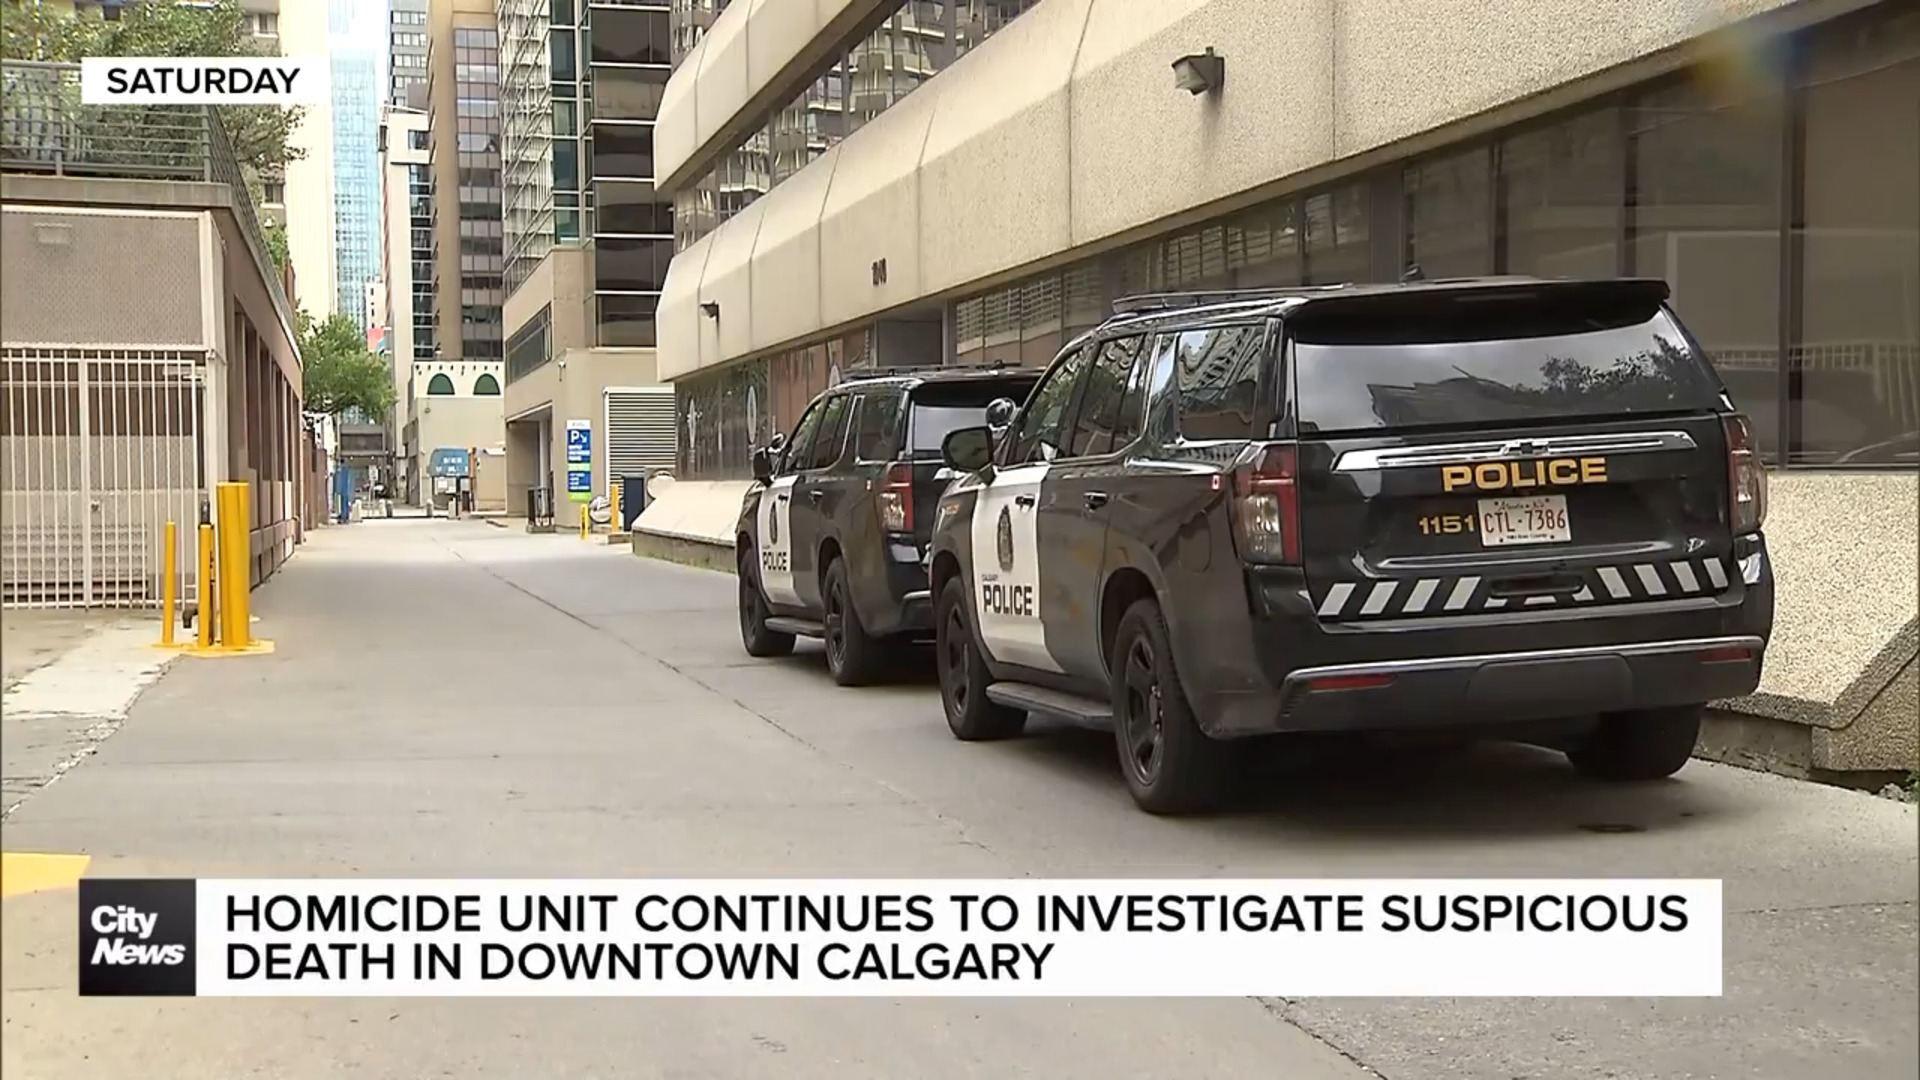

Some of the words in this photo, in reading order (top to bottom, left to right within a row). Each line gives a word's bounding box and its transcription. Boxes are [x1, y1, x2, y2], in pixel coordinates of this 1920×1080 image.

[571, 430, 580, 443] P
[1442, 457, 1608, 492] POLICE
[1419, 514, 1475, 535] 1151
[762, 551, 787, 571] POLICE
[983, 584, 1032, 616] POLICE
